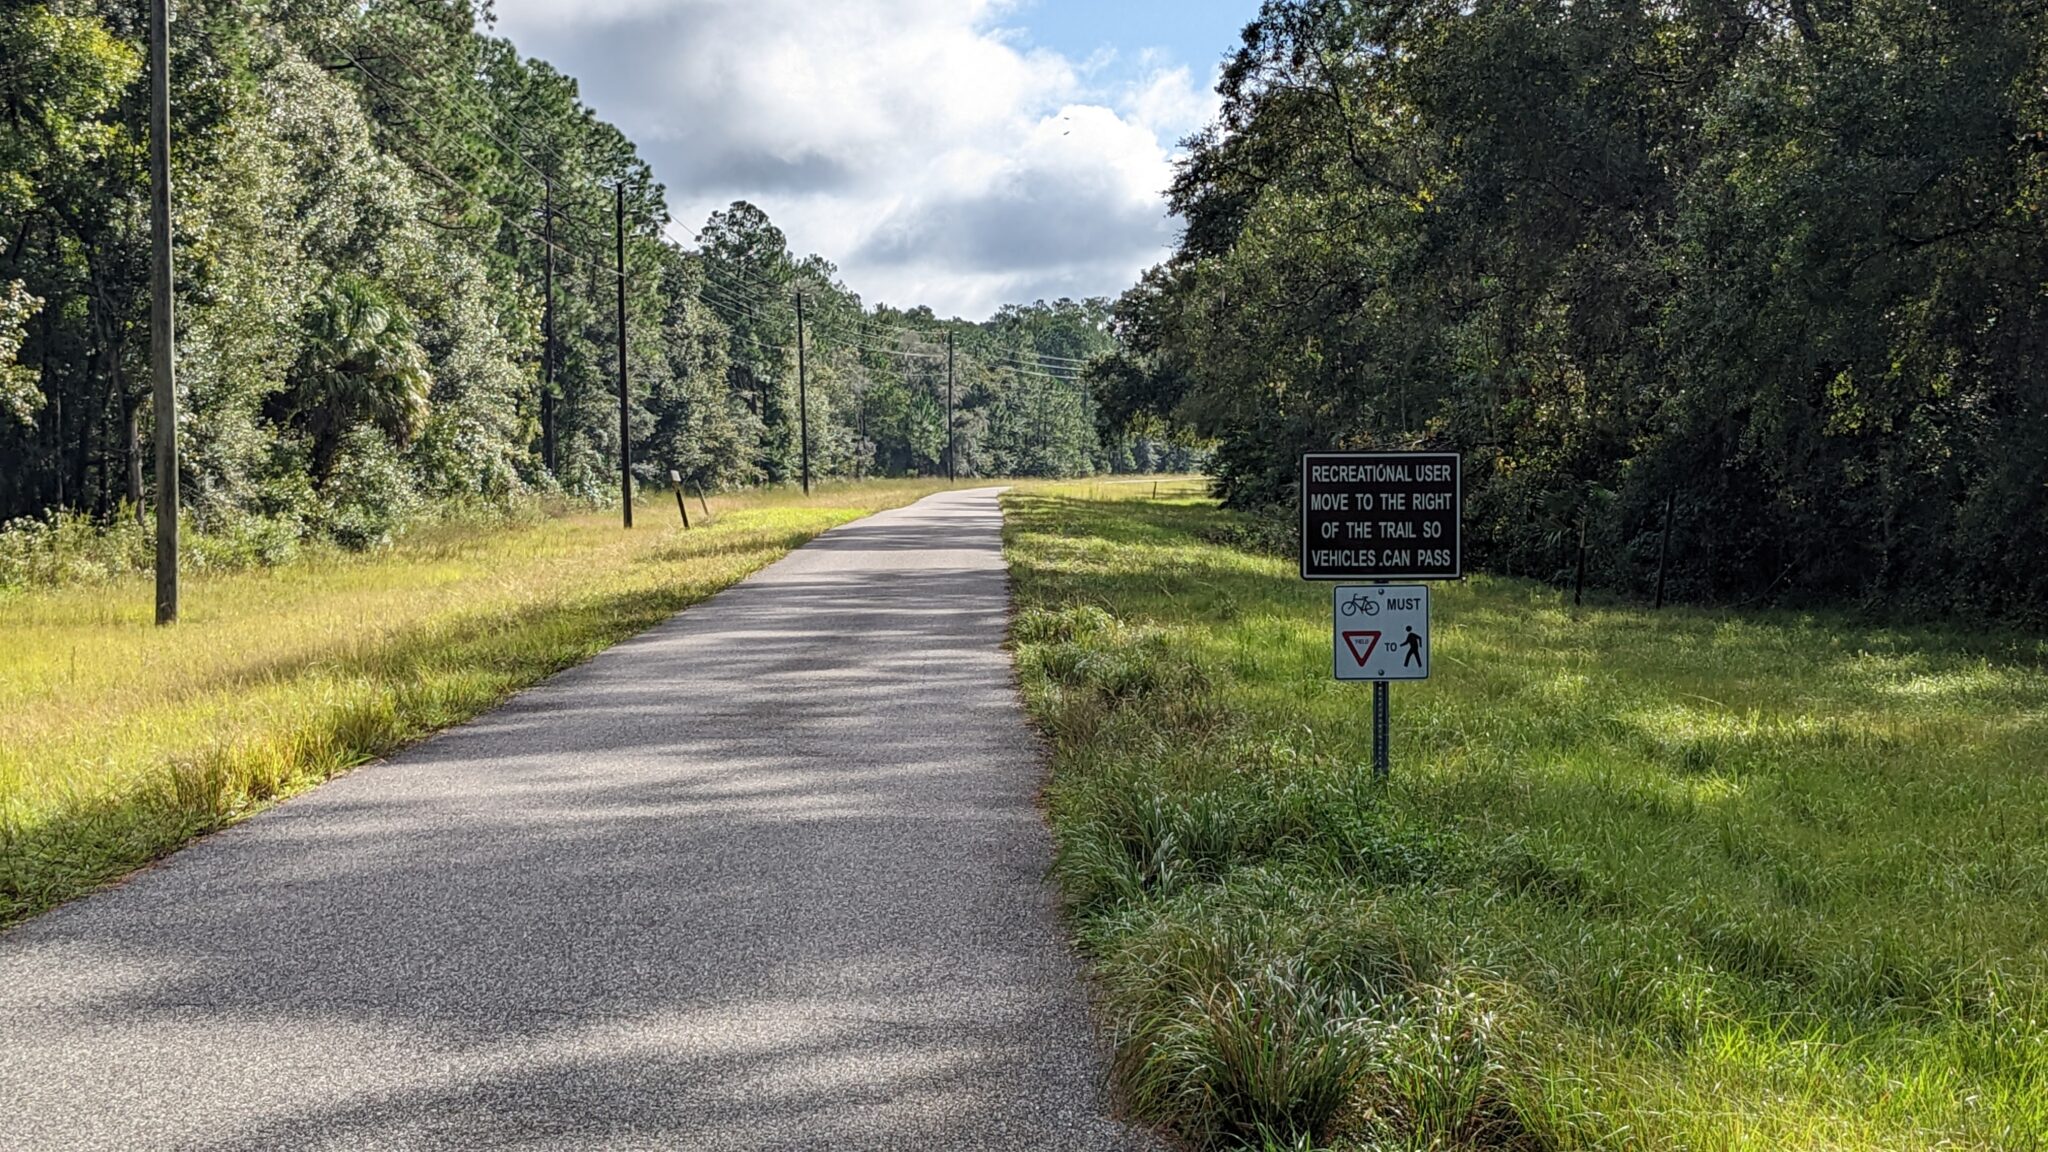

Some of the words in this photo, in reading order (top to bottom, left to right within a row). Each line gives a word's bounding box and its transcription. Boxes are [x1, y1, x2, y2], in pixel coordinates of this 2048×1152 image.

[1312, 465, 1412, 482] RECREATIONAL
[1415, 465, 1451, 482] USER
[1311, 494, 1349, 511] MOVE
[1355, 493, 1373, 510] TO
[1380, 493, 1405, 510] THE
[1413, 493, 1452, 510] RIGHT
[1321, 522, 1339, 539] OF
[1347, 522, 1372, 538] THE
[1379, 522, 1416, 538] TRAIL
[1423, 521, 1441, 538] SO
[1312, 550, 1376, 567] VEHICLES
[1418, 549, 1451, 566] PASS
[1387, 598, 1421, 610] MUST
[1385, 643, 1397, 652] TO
